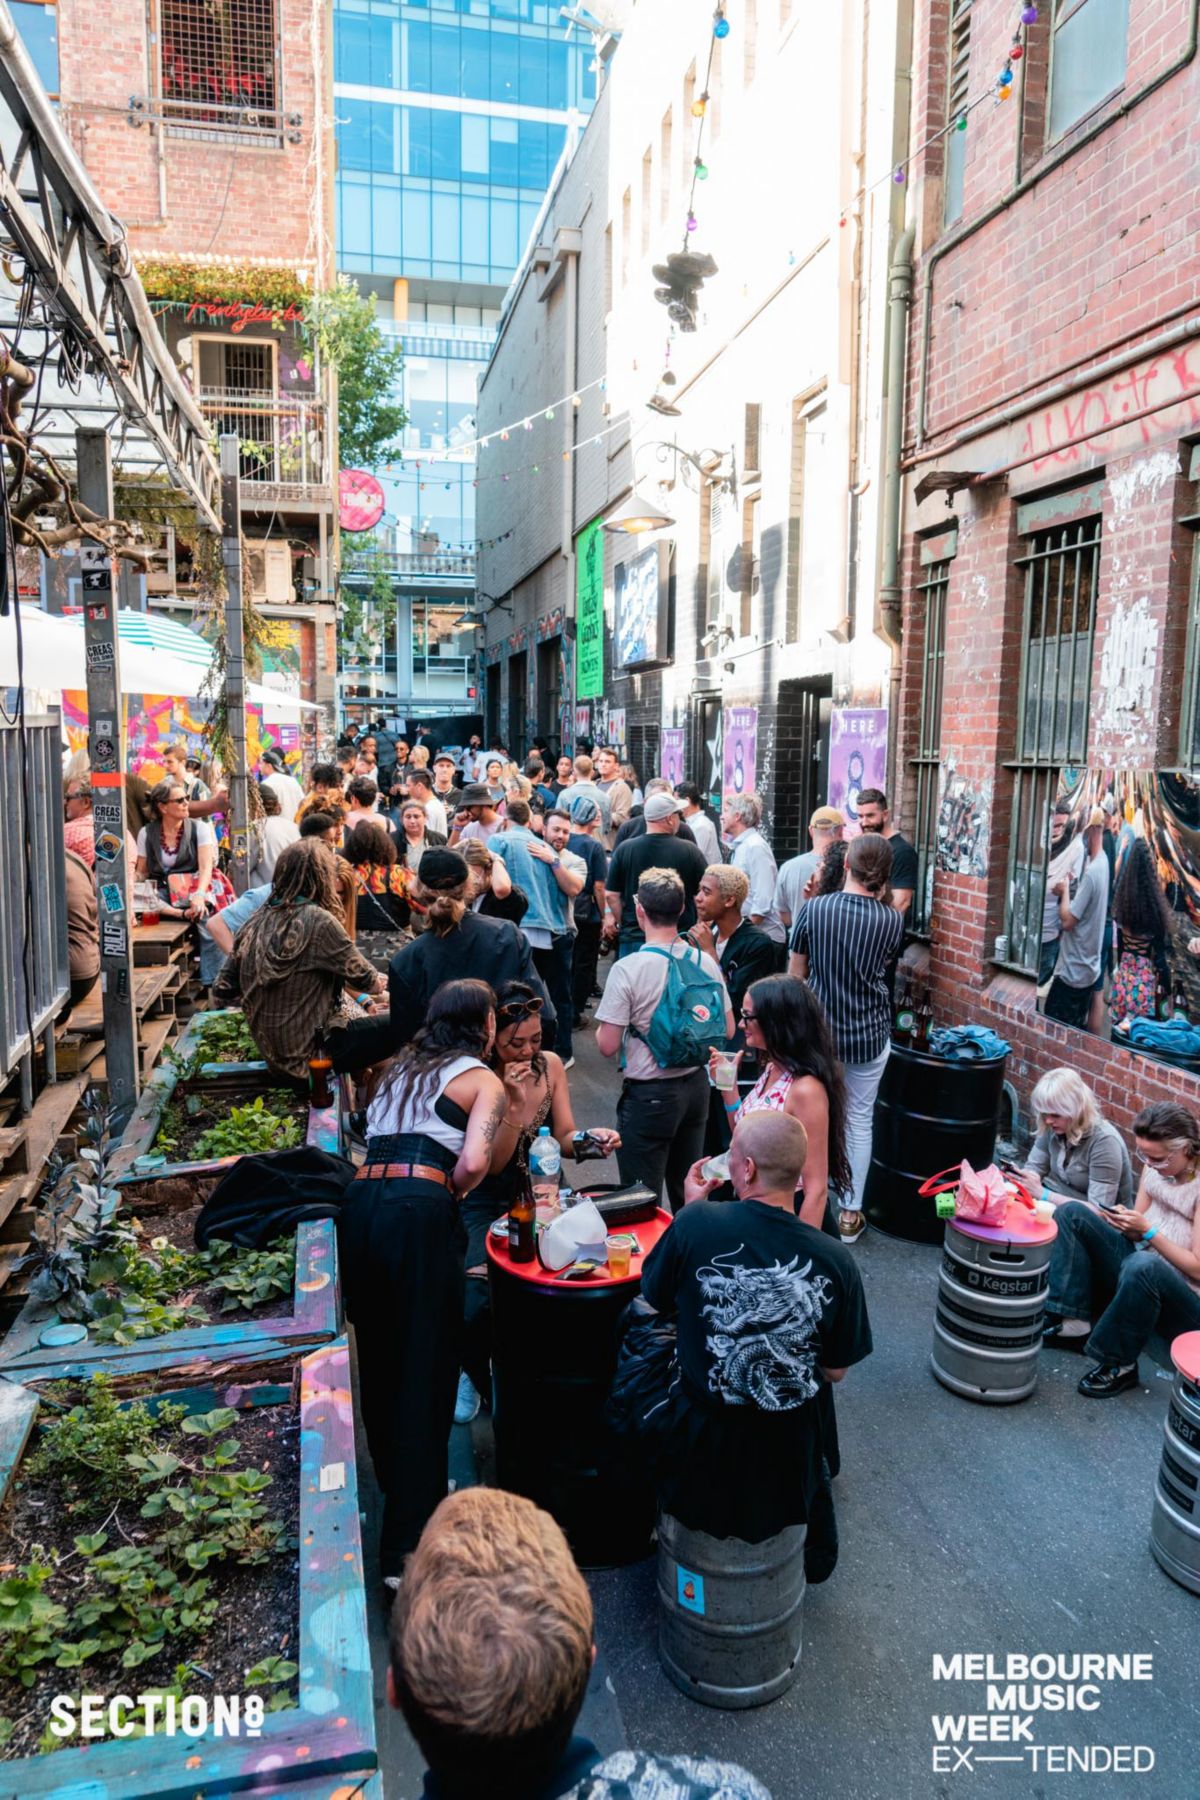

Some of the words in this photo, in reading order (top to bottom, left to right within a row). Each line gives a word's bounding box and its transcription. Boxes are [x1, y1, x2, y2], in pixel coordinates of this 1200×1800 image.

[87, 643, 113, 658] CREAS
[840, 719, 875, 733] HERE
[94, 806, 120, 817] CREAS
[983, 1275, 1033, 1294] Kegstar
